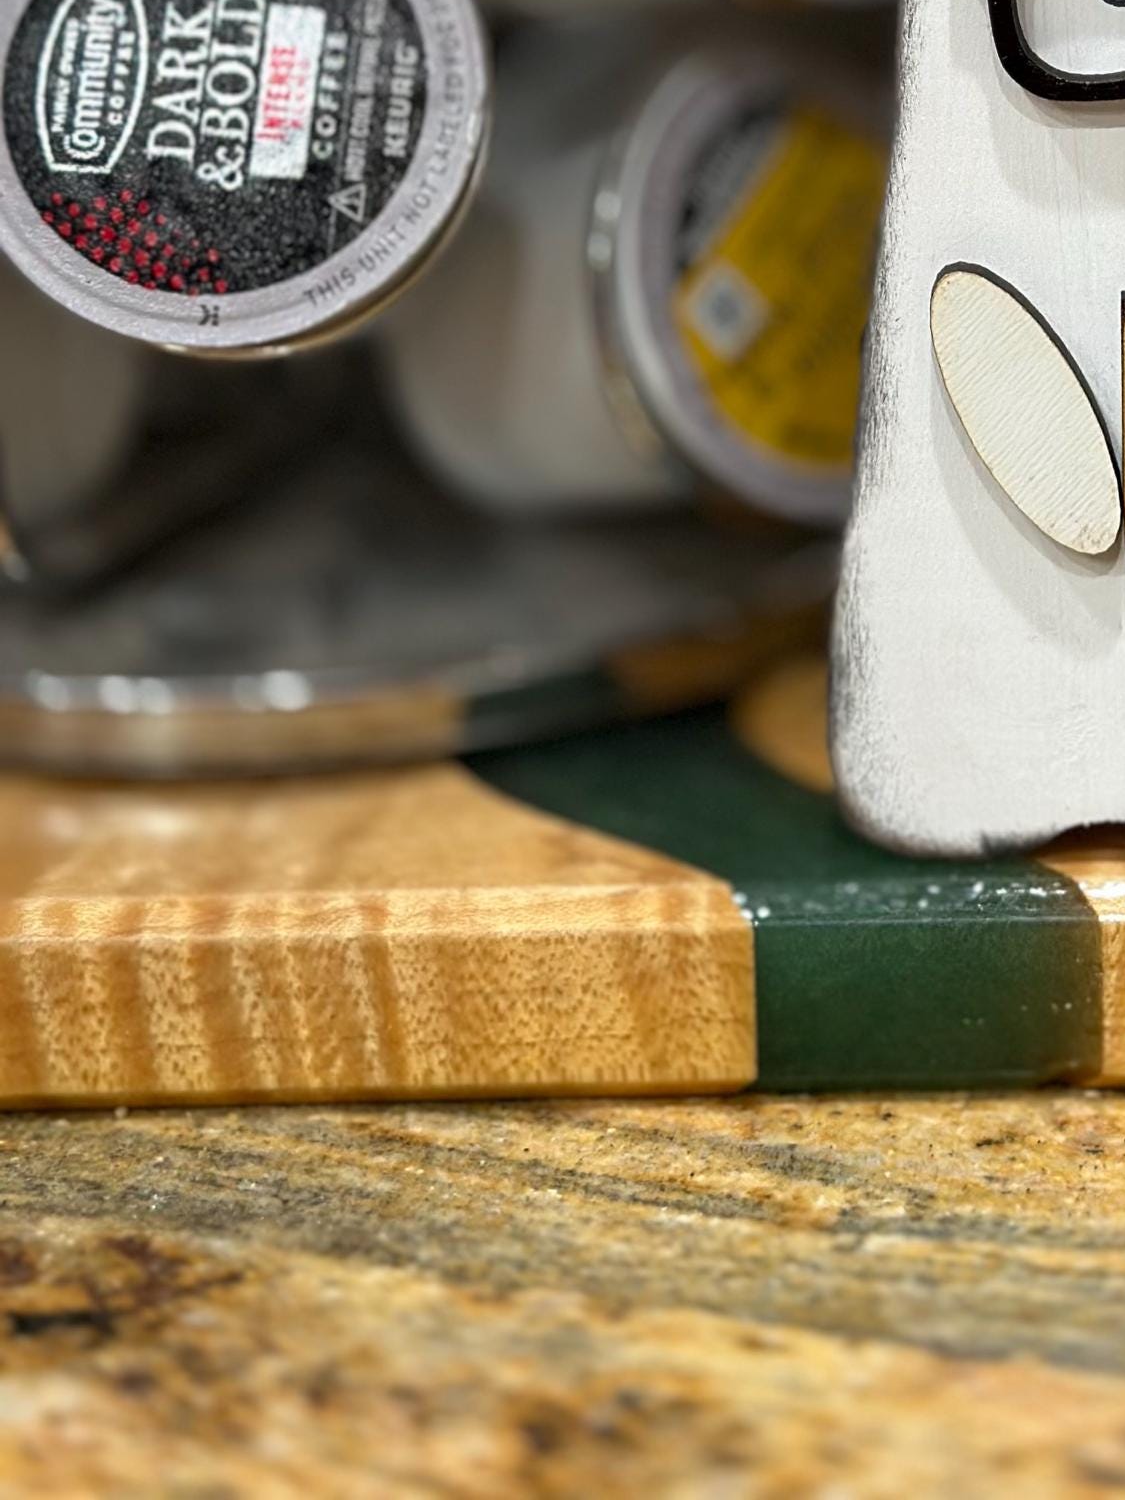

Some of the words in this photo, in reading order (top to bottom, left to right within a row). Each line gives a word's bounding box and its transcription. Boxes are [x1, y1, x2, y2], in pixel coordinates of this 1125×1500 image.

[106, 30, 136, 126] COFFEE
[145, 0, 216, 171] DARK
[256, 46, 297, 142] INTENSE
[312, 32, 349, 160] COFFEE
[382, 41, 420, 158] KEURIG
[303, 270, 357, 308] THIS
[358, 223, 406, 273] UNIT
[401, 179, 438, 225] NOT
